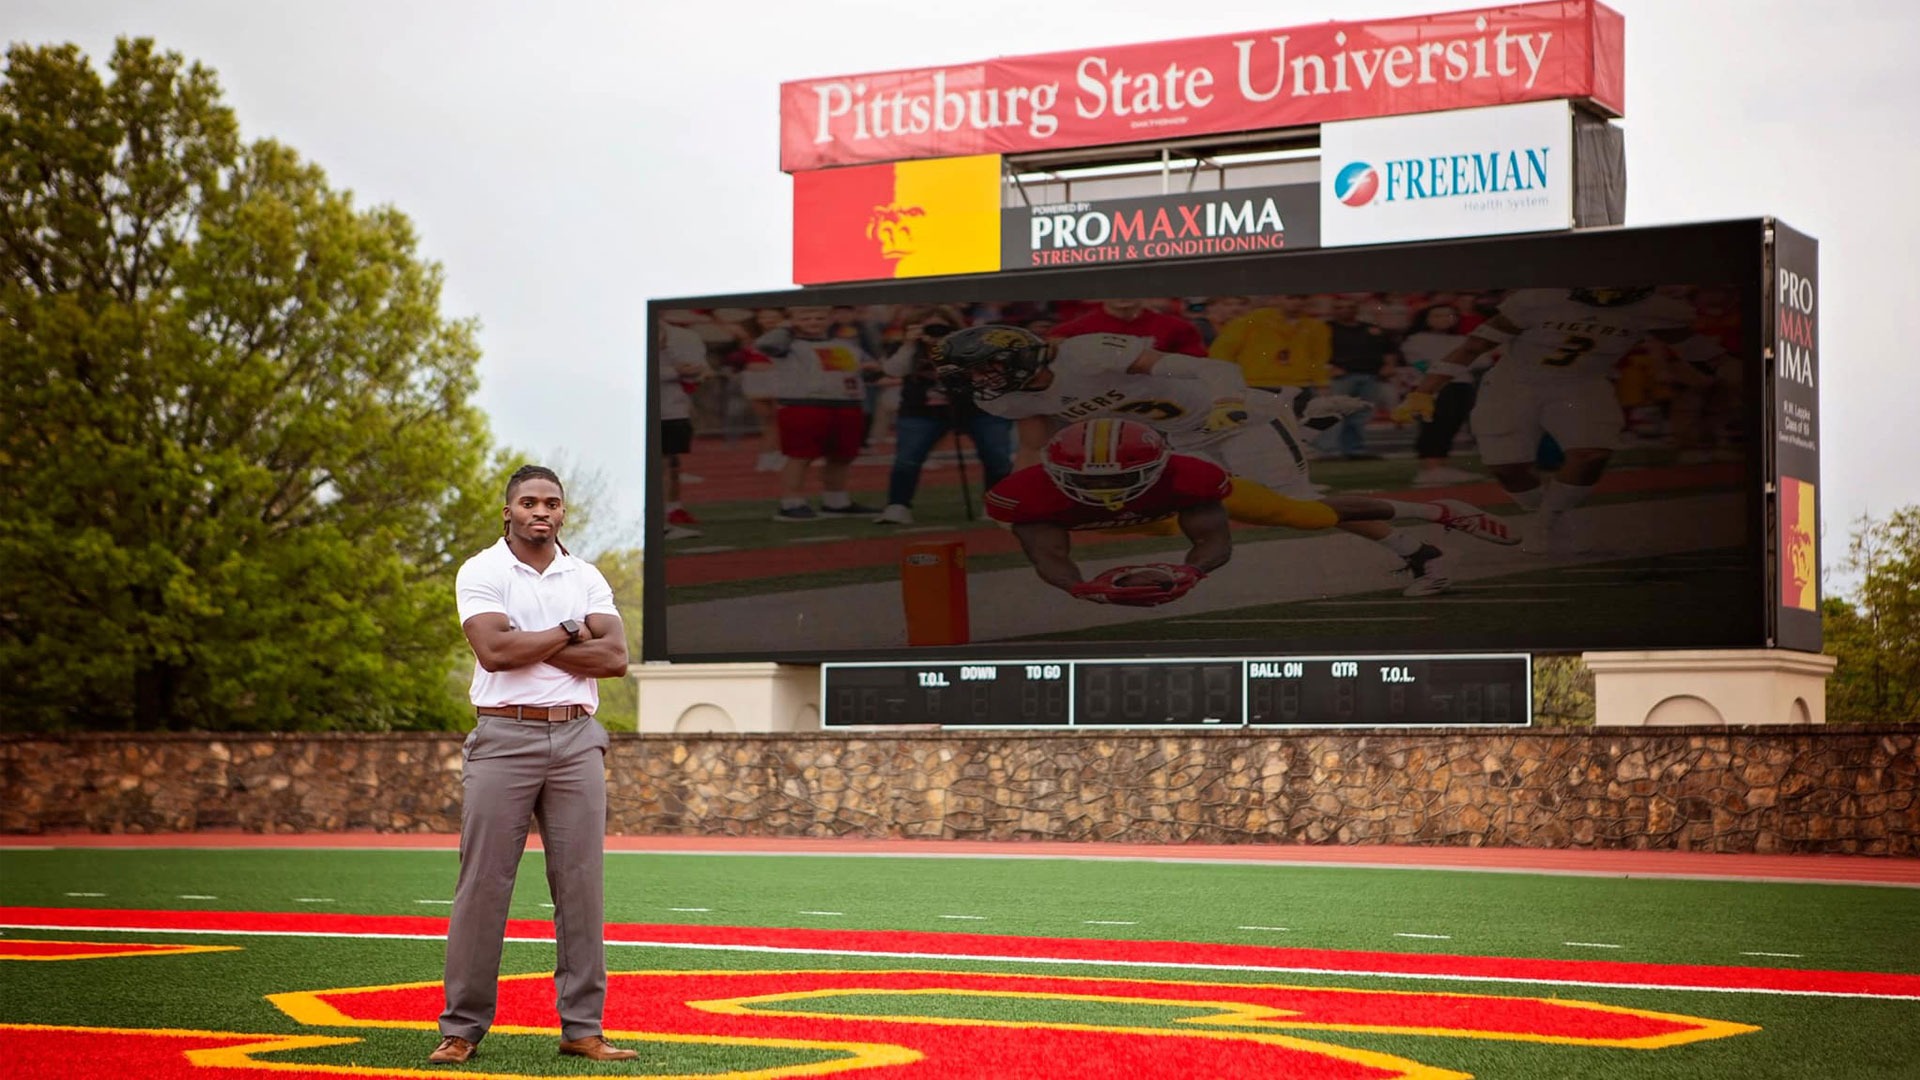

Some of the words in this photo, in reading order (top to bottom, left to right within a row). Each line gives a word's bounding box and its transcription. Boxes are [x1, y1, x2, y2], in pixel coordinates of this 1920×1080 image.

[813, 71, 1059, 145] Pittsburg
[1075, 56, 1214, 119] State
[1234, 16, 1552, 102] University
[1385, 147, 1549, 203] FREEMAN
[1032, 203, 1076, 216] POWERED
[1464, 199, 1502, 211] Health
[1507, 195, 1549, 211] System
[1031, 198, 1284, 250] PROMAXIMA
[1032, 246, 1120, 267] STRENGTH
[1126, 245, 1139, 259] &
[1144, 233, 1284, 258] CONDITIONING
[1780, 267, 1813, 315] PRO
[1780, 305, 1813, 350] MAX
[1780, 339, 1814, 388] IMA
[1060, 389, 1126, 419] IGERS
[918, 672, 950, 687] T.O.L.
[960, 666, 997, 680] DOWN
[1026, 666, 1042, 680] TO
[1043, 665, 1061, 680] GO
[1250, 663, 1282, 678] BALL
[1283, 662, 1303, 678] ON
[1331, 661, 1358, 678] QTR
[1380, 666, 1416, 683] T.O.L.
